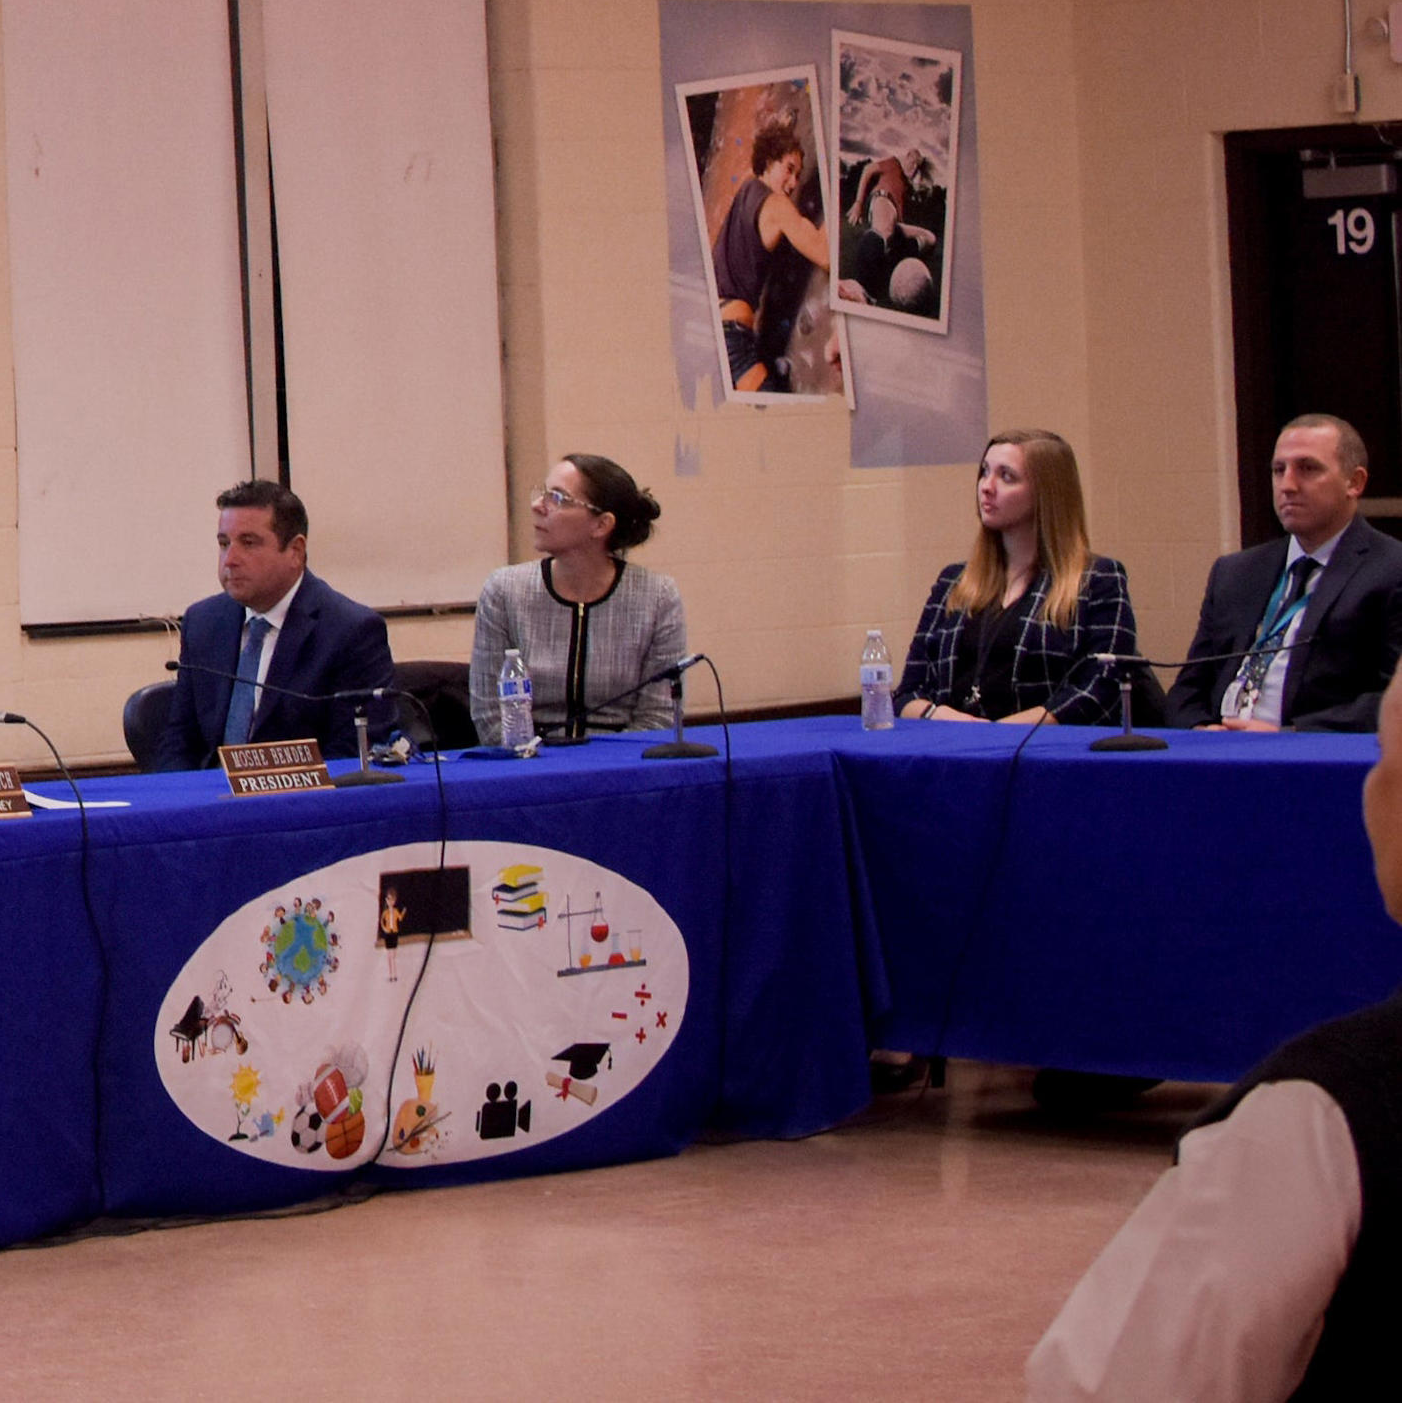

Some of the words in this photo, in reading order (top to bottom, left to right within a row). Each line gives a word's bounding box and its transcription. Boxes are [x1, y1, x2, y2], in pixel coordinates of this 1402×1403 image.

[1327, 206, 1376, 256] 19
[230, 748, 269, 768] MOSHE
[270, 744, 314, 765] BENDER
[238, 771, 322, 792] PRESIDENT
